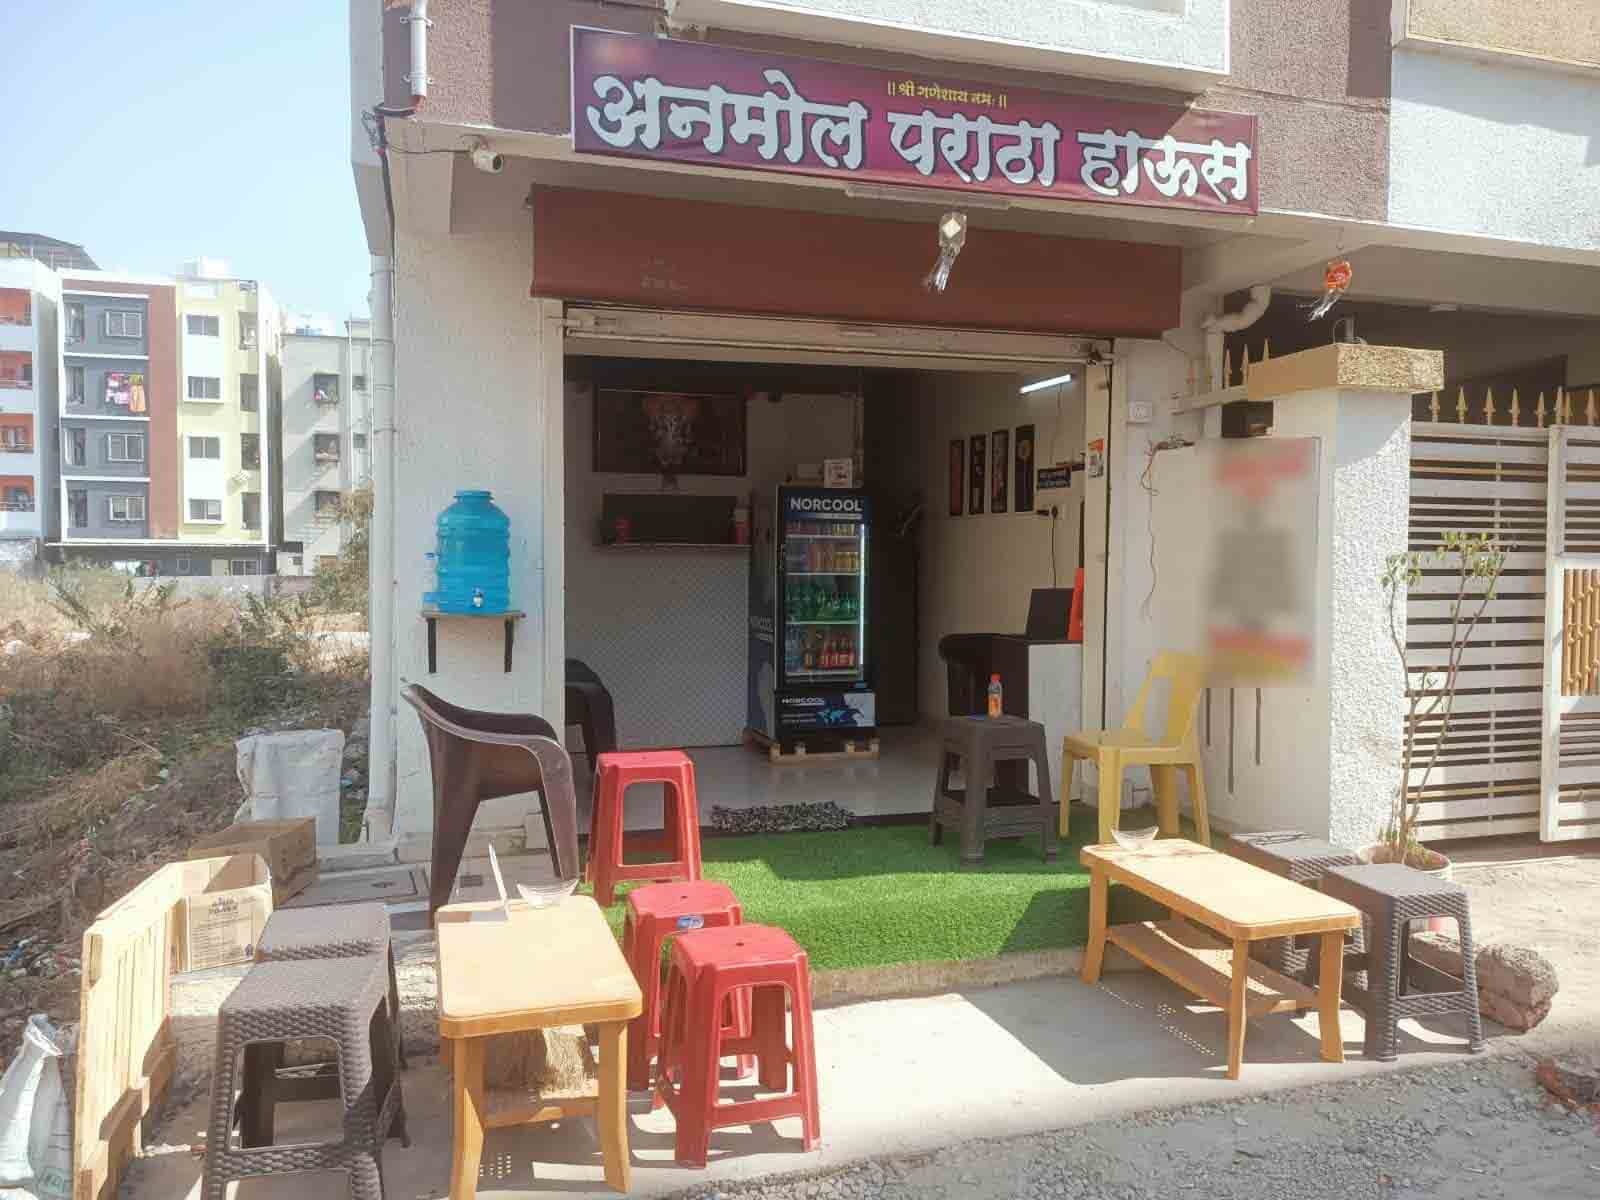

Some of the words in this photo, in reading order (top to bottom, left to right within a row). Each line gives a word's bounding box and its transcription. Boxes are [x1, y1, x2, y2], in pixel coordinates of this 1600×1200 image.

[586, 69, 868, 169] अनमोल
[888, 109, 1060, 186] पराठा
[1077, 128, 1251, 202] हाऊस
[790, 497, 863, 512] NORCOOL
